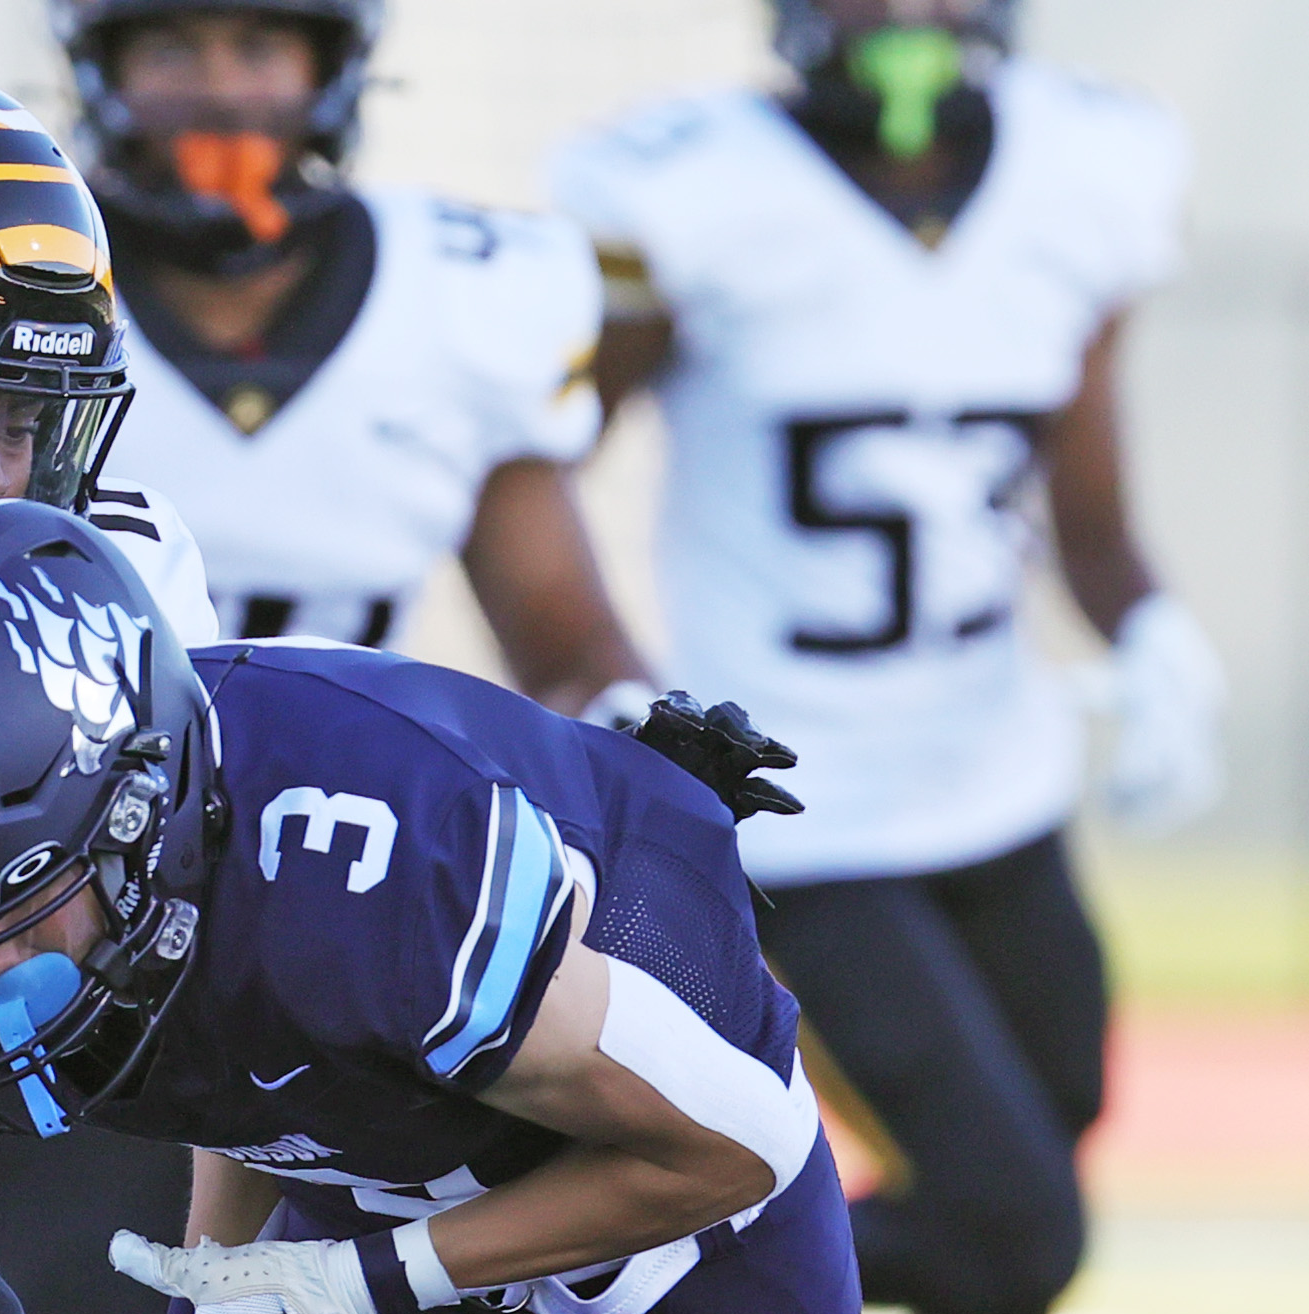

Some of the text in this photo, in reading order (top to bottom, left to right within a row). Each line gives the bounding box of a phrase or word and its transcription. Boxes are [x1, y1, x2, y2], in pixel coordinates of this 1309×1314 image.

[13, 325, 94, 356] Riddell
[784, 408, 1034, 656] 53
[258, 786, 400, 894] 3
